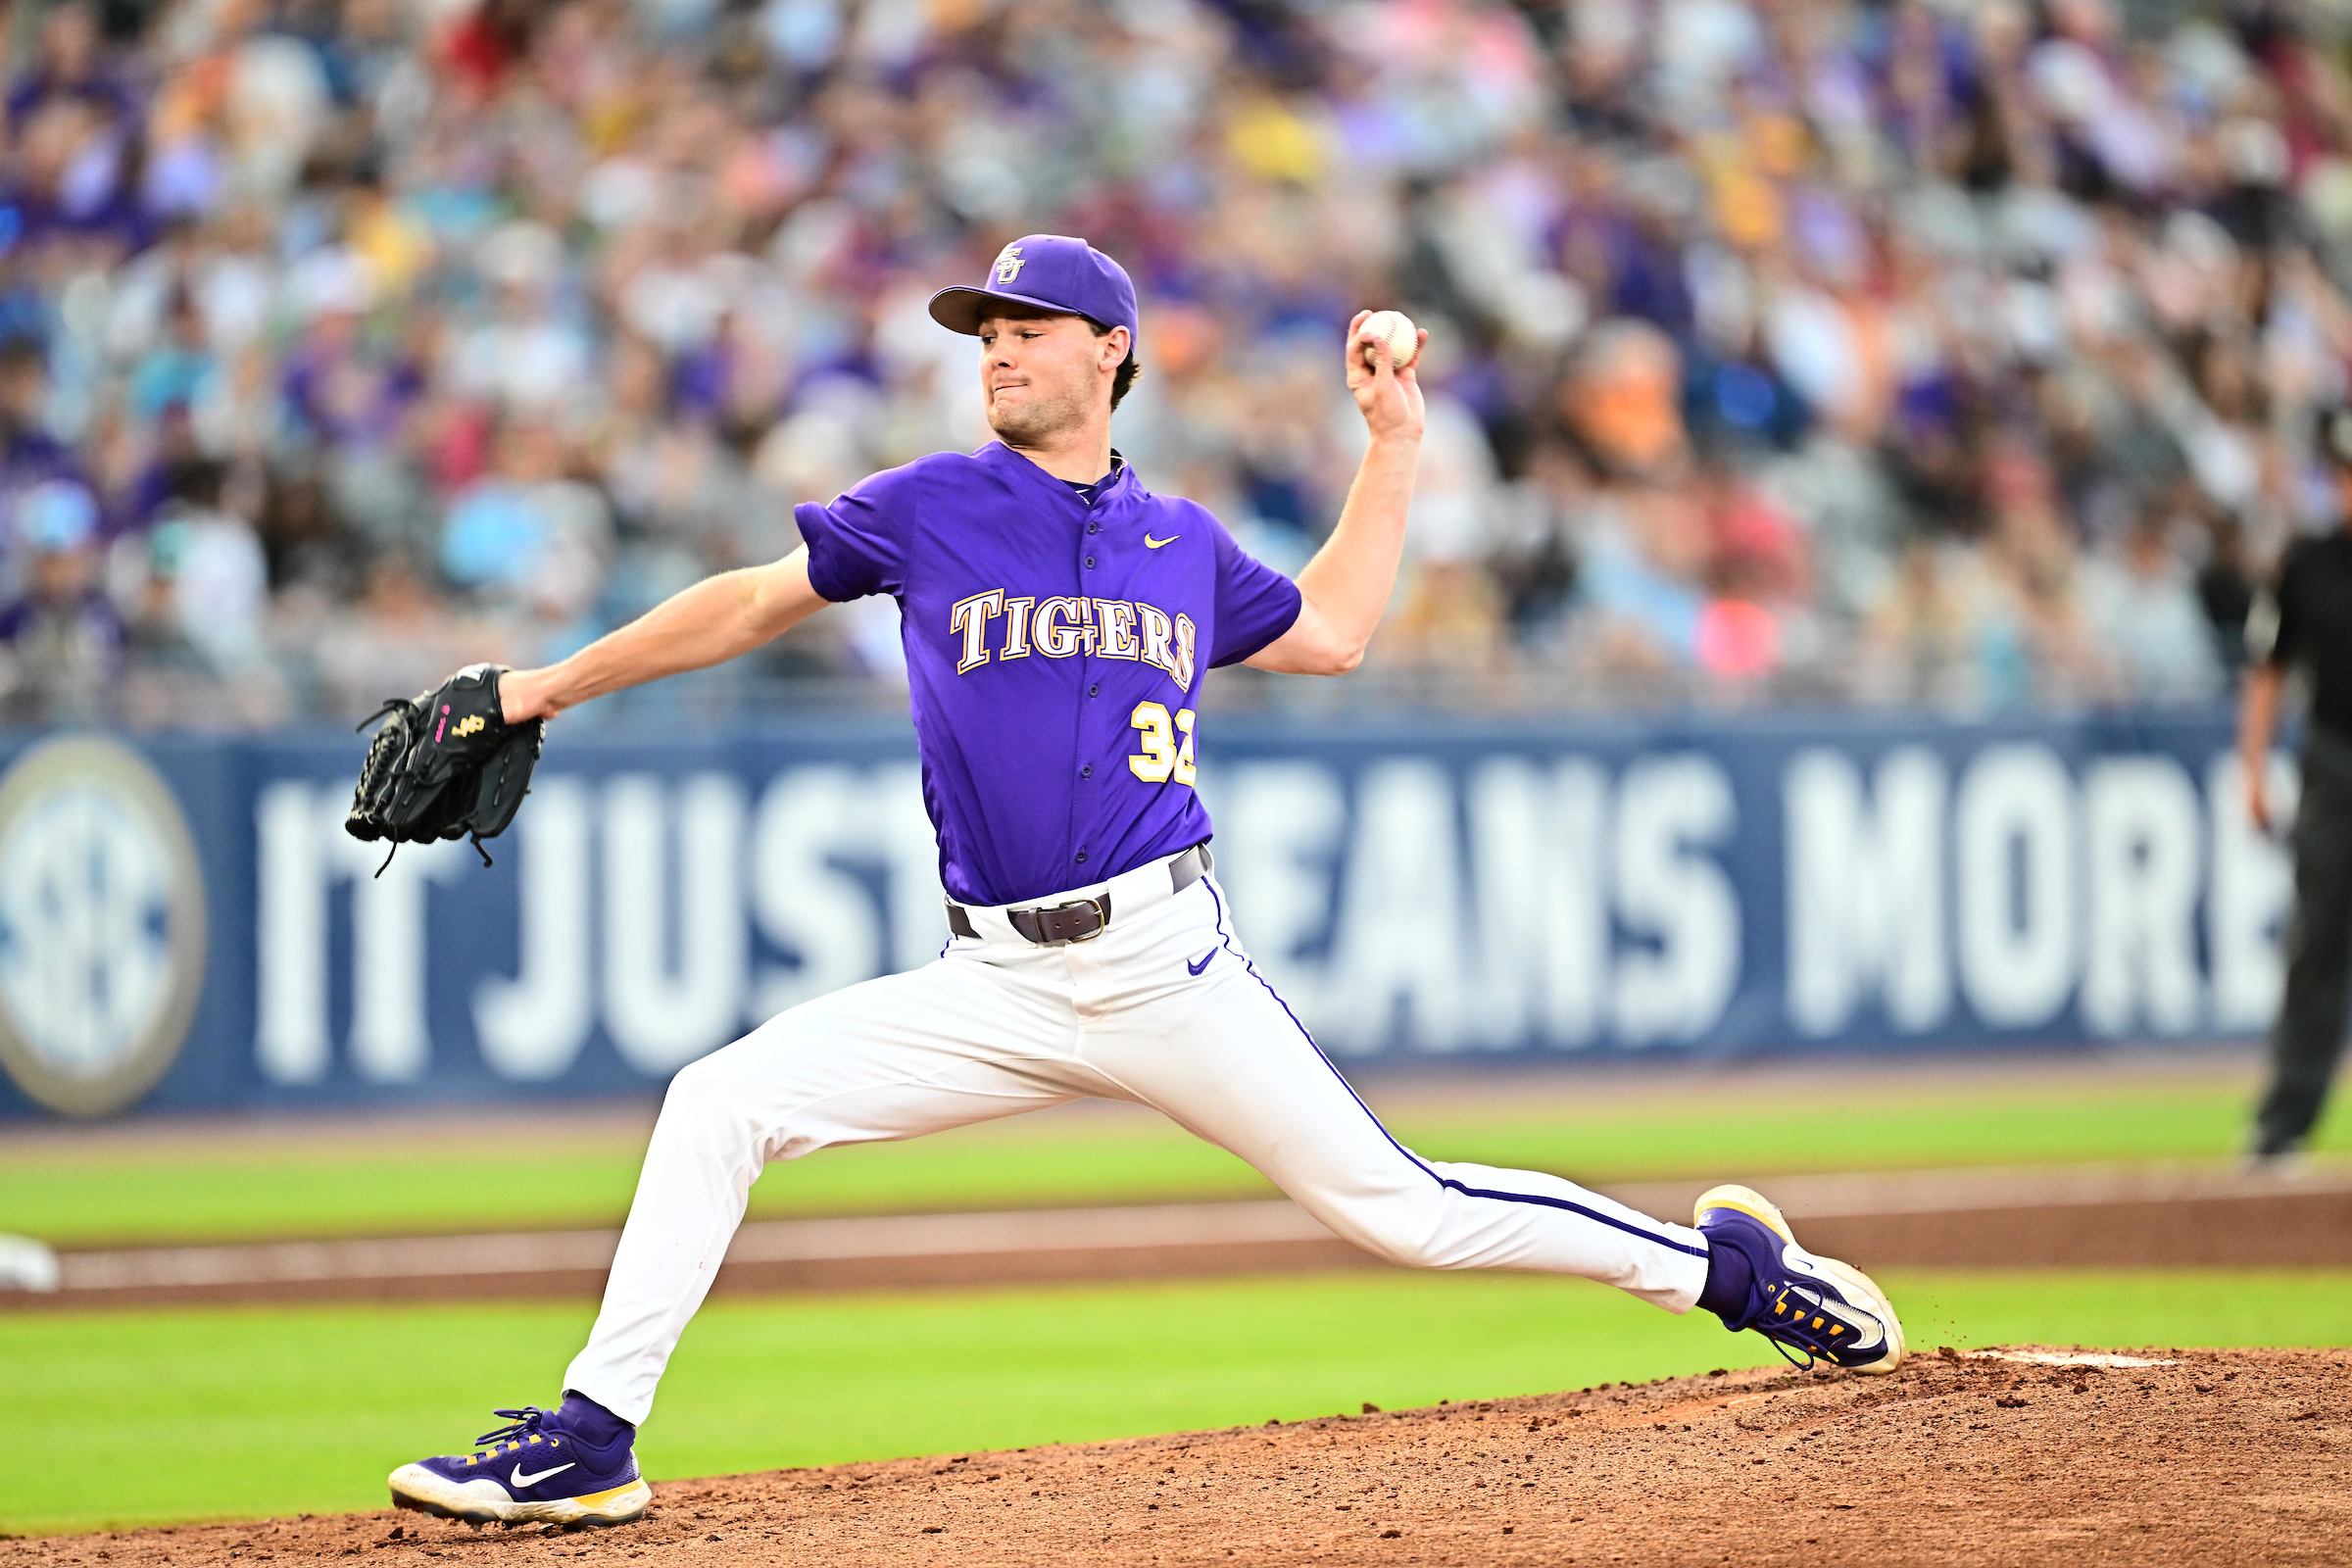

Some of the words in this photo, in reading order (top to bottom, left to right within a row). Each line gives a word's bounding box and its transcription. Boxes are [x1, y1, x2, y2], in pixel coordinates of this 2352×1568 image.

[950, 588, 1197, 693] TIGERS
[1128, 701, 1198, 788] 32
[255, 779, 468, 1081] IT
[1198, 751, 1743, 1056] EANS
